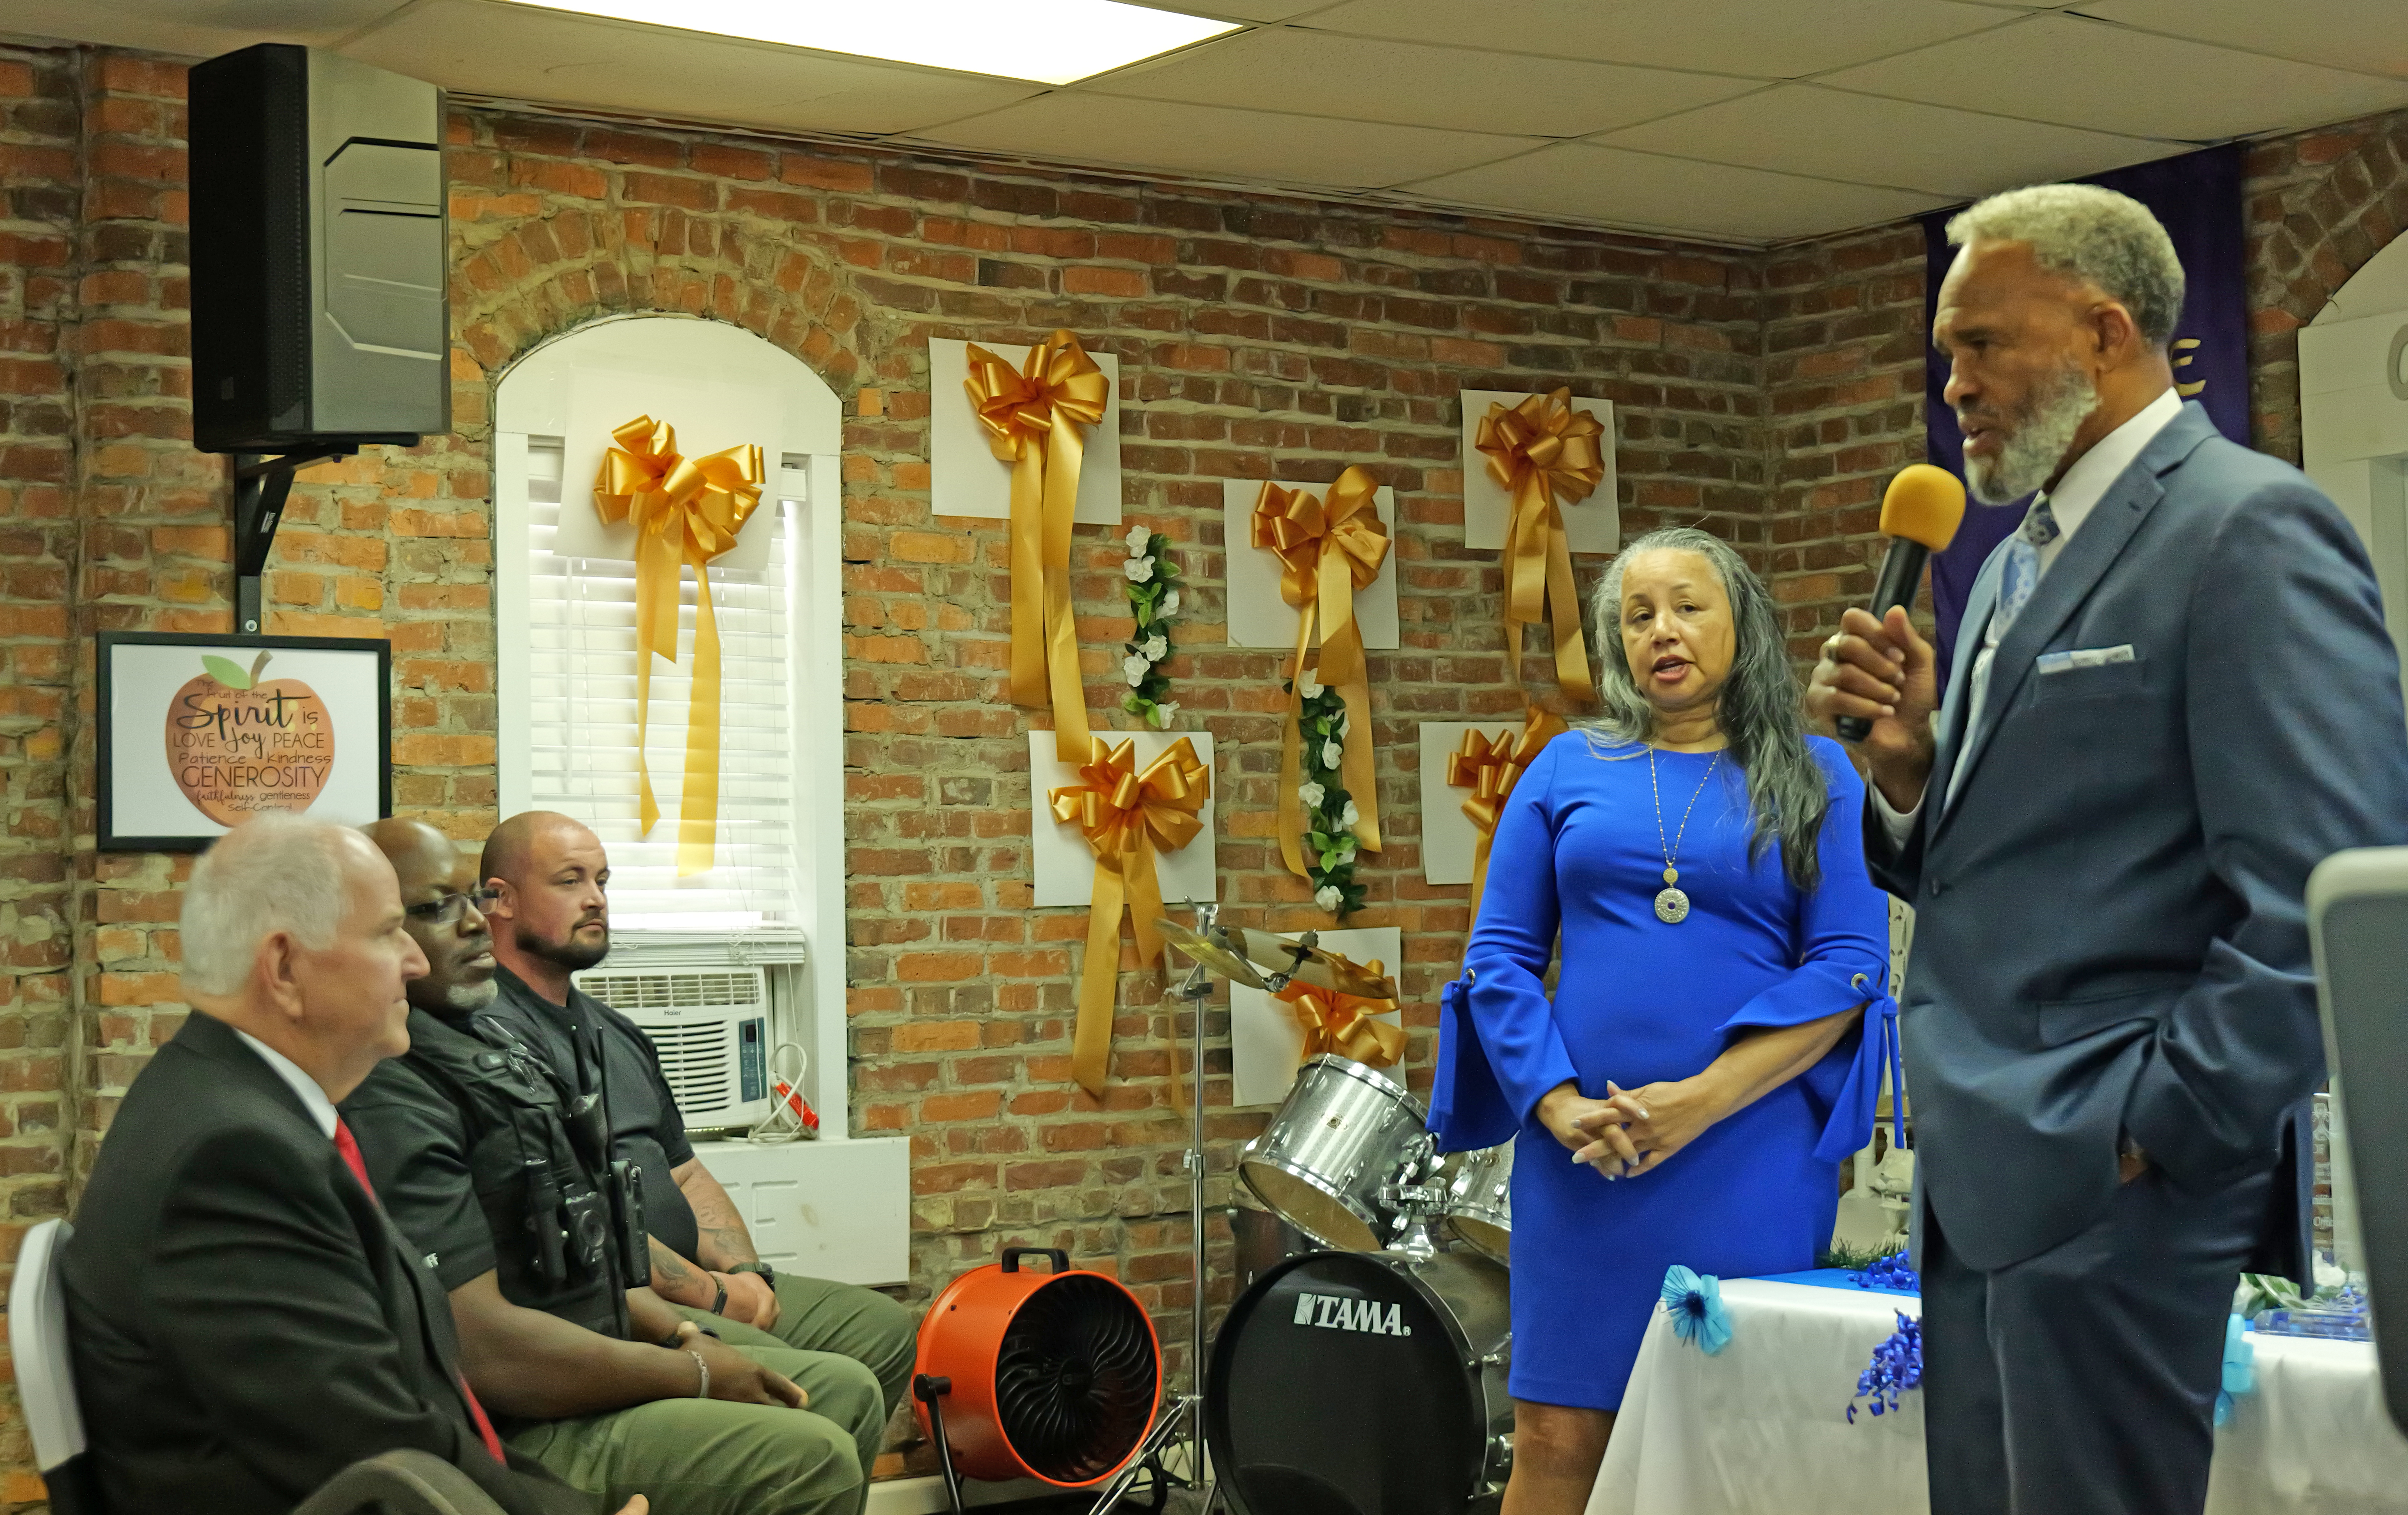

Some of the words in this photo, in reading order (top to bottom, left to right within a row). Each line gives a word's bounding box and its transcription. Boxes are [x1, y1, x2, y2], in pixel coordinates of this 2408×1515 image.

[235, 689, 247, 698] of
[176, 688, 311, 741] Spirit
[302, 706, 318, 725] is
[174, 733, 215, 748] LOVE
[224, 726, 266, 759] Joy
[273, 733, 325, 748] PEACE
[178, 752, 247, 764] Patience
[182, 766, 325, 787] GENEROSITY
[197, 790, 255, 806] faithfulness
[260, 790, 311, 801] gentleness
[1314, 1295, 1402, 1336] TAMA
